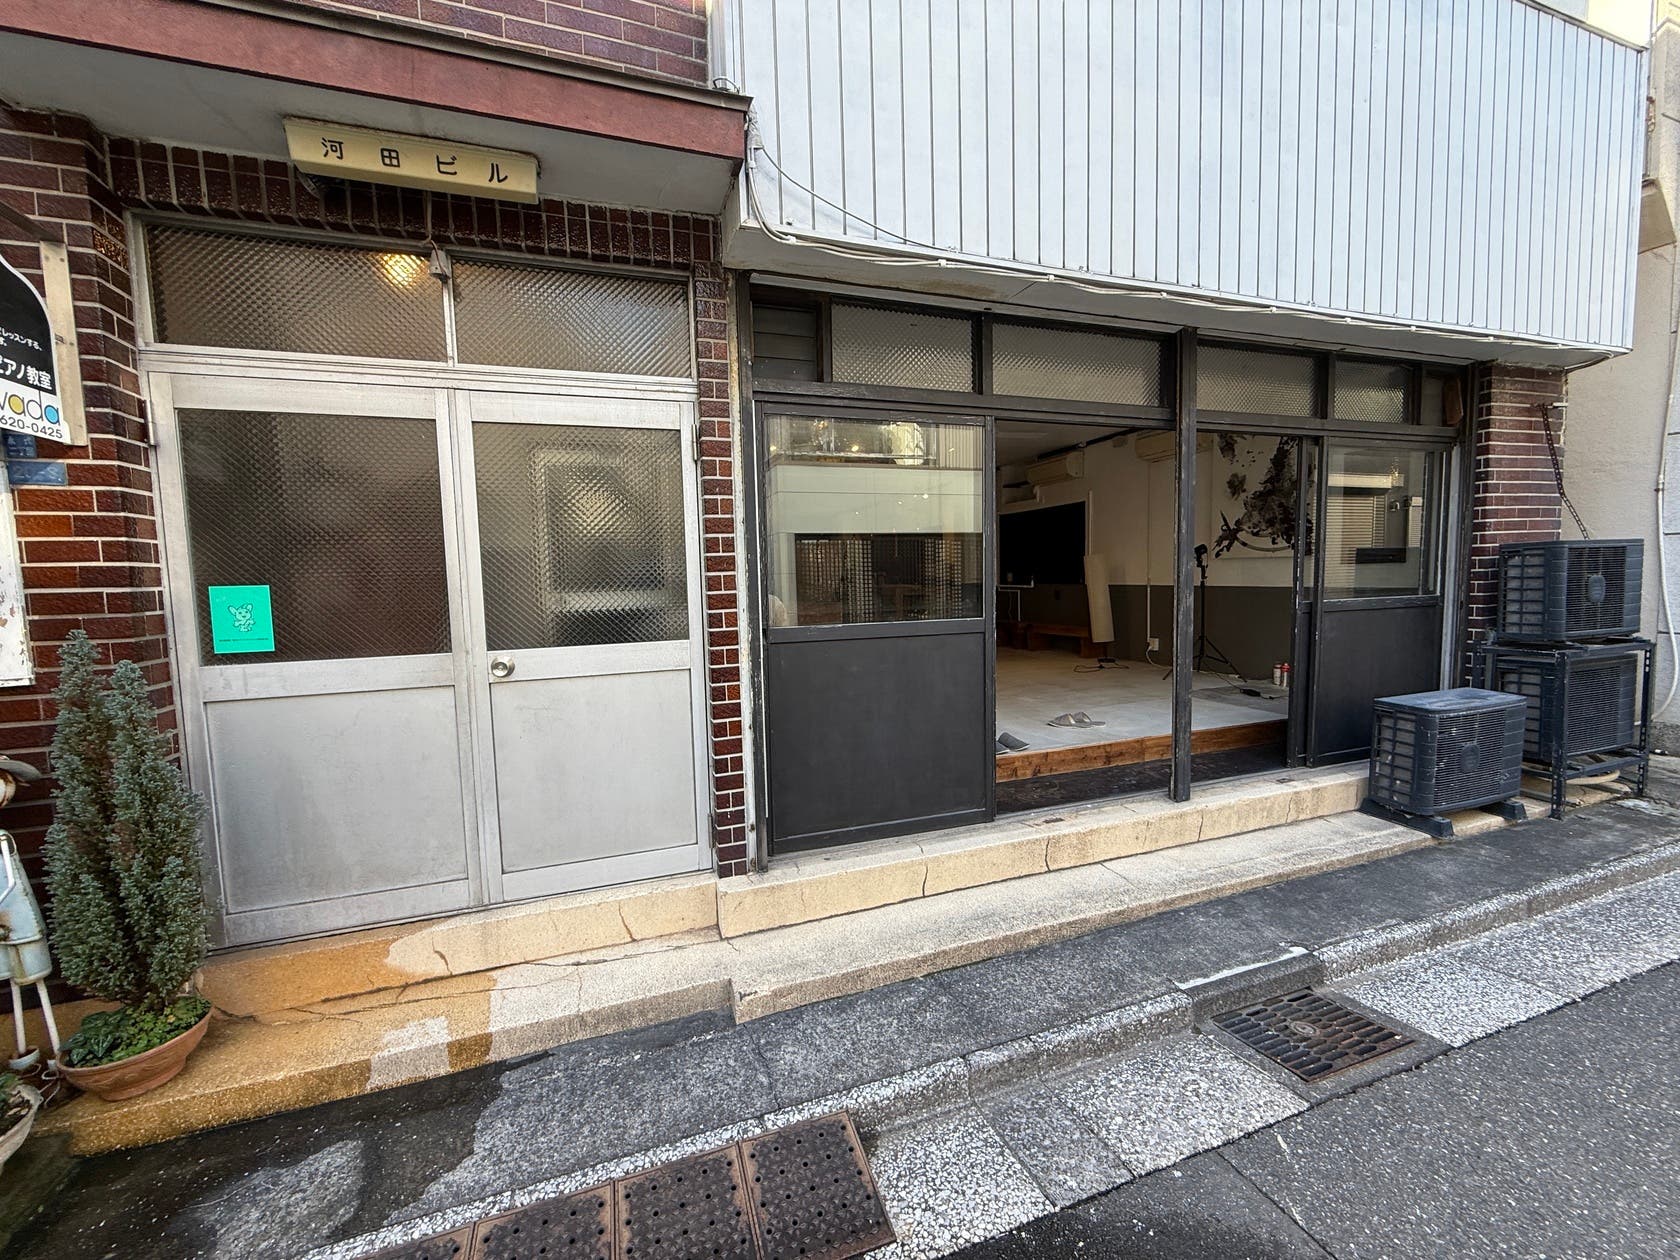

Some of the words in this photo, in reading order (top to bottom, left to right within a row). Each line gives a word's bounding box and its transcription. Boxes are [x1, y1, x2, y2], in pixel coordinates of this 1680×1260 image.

[321, 137, 508, 184] 河田ビル
[0, 327, 42, 351] レッスンする、
[0, 415, 63, 439] 620-0425
